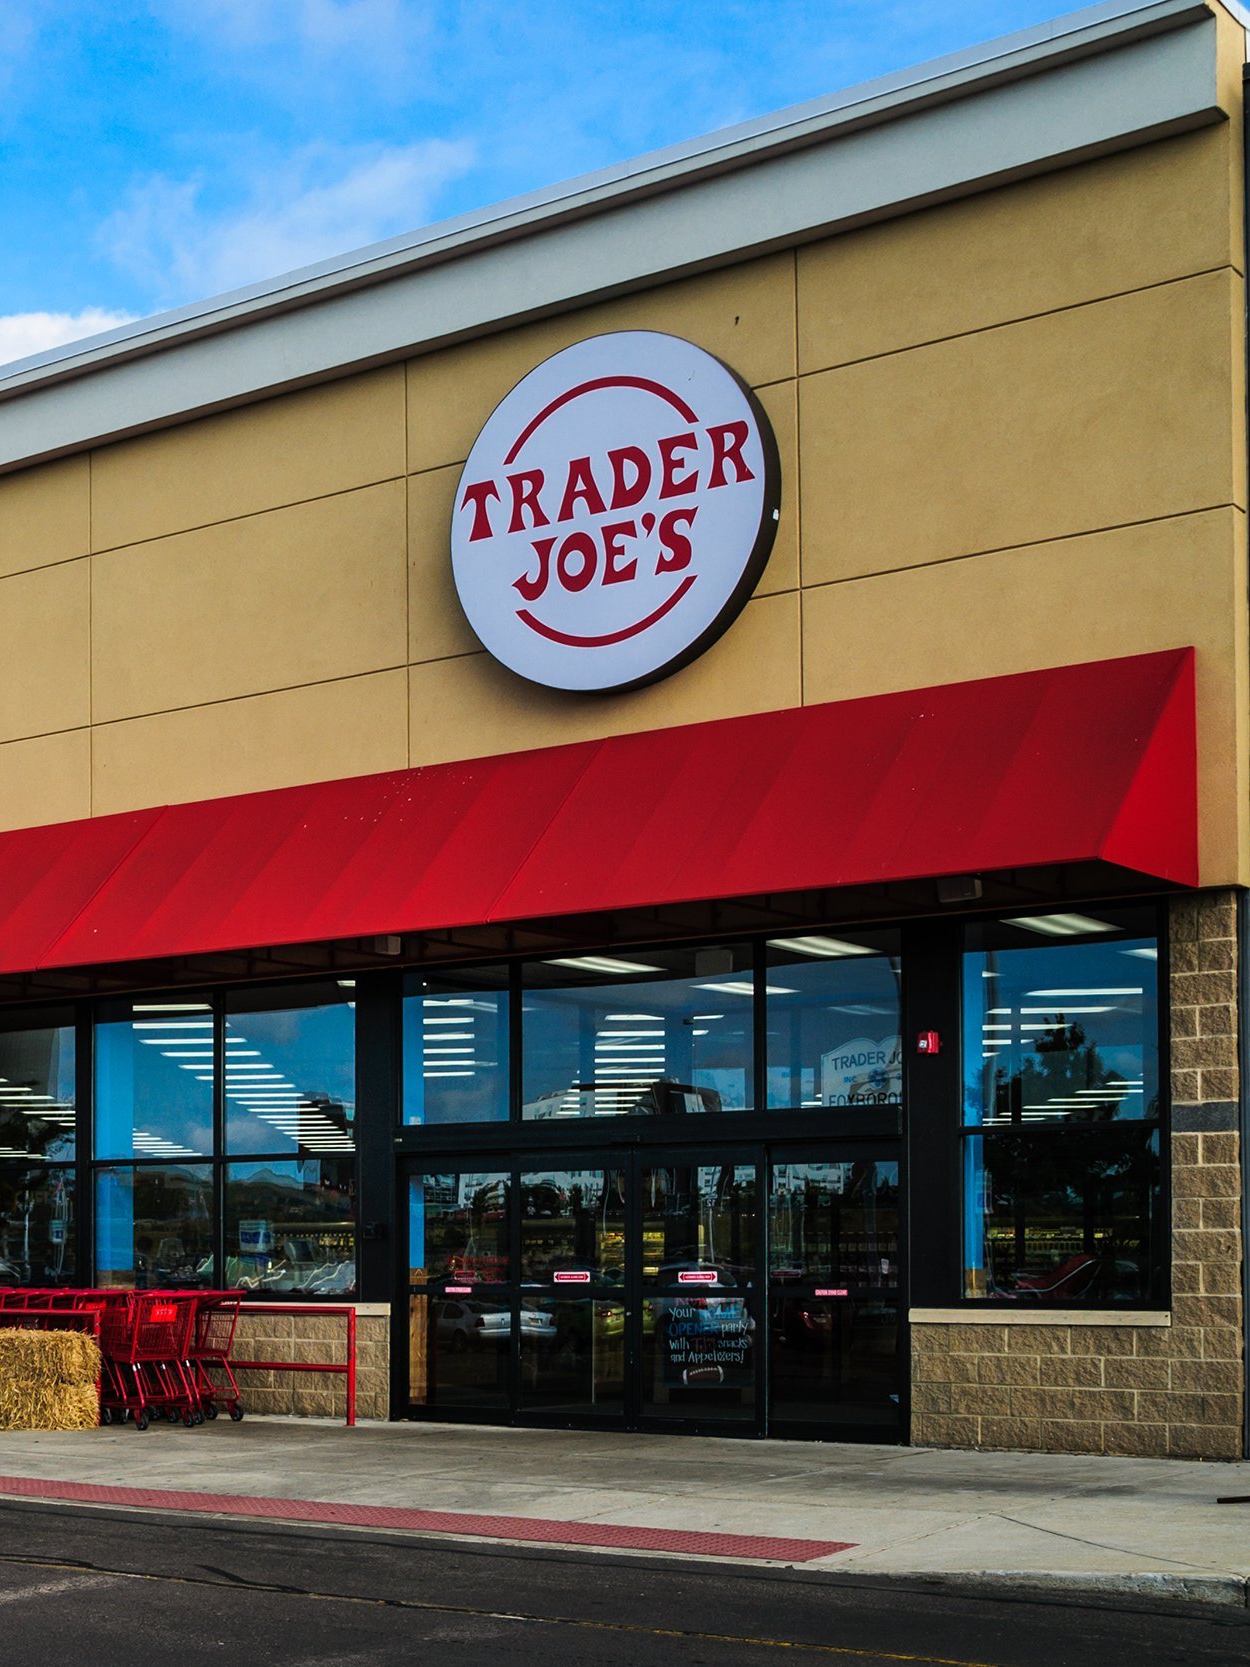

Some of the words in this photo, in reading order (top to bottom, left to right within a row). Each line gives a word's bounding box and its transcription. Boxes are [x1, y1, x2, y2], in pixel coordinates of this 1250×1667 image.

[460, 420, 756, 542] TRADER
[511, 505, 699, 602] JOE'S
[832, 1051, 886, 1071] TRADER
[669, 1307, 695, 1321] your
[721, 1320, 748, 1337] party
[669, 1337, 690, 1350] with
[717, 1338, 748, 1349] snacks
[670, 1351, 686, 1362] and
